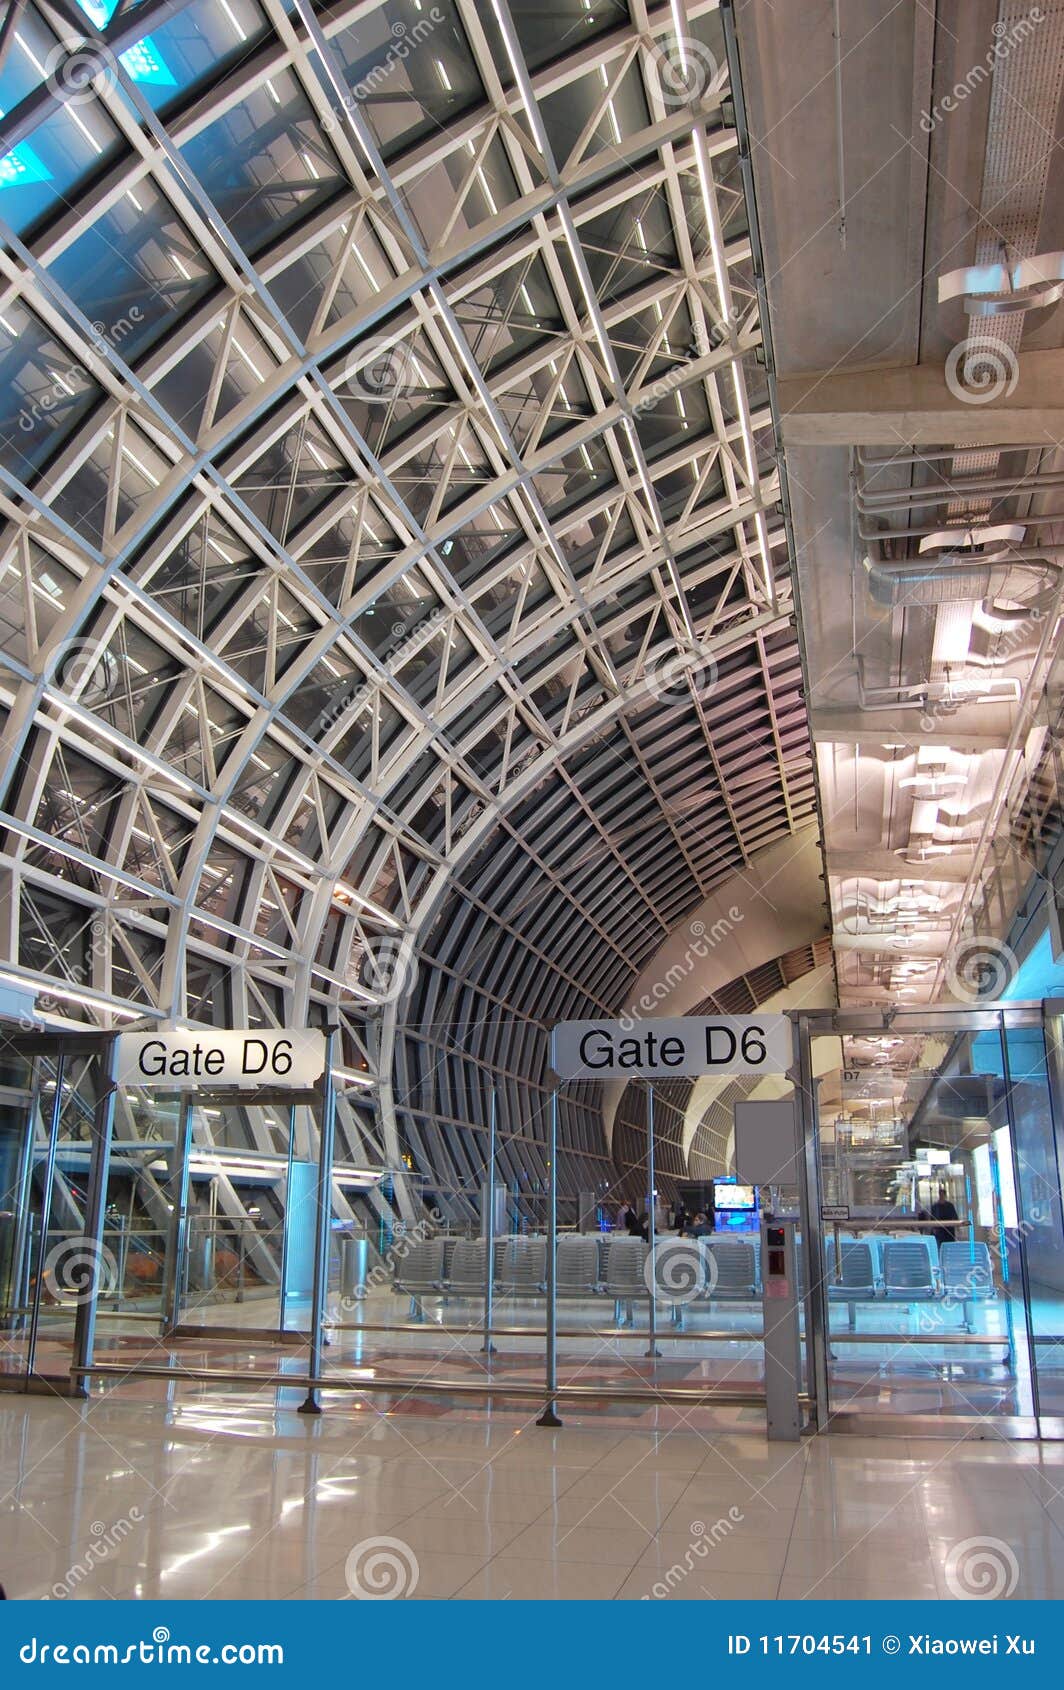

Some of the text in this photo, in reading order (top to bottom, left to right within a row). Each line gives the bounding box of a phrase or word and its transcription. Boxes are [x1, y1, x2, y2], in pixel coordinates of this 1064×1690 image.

[138, 1039, 293, 1076] Gate D6
[579, 1025, 767, 1069] Gate D6
[844, 1071, 860, 1081] D7
